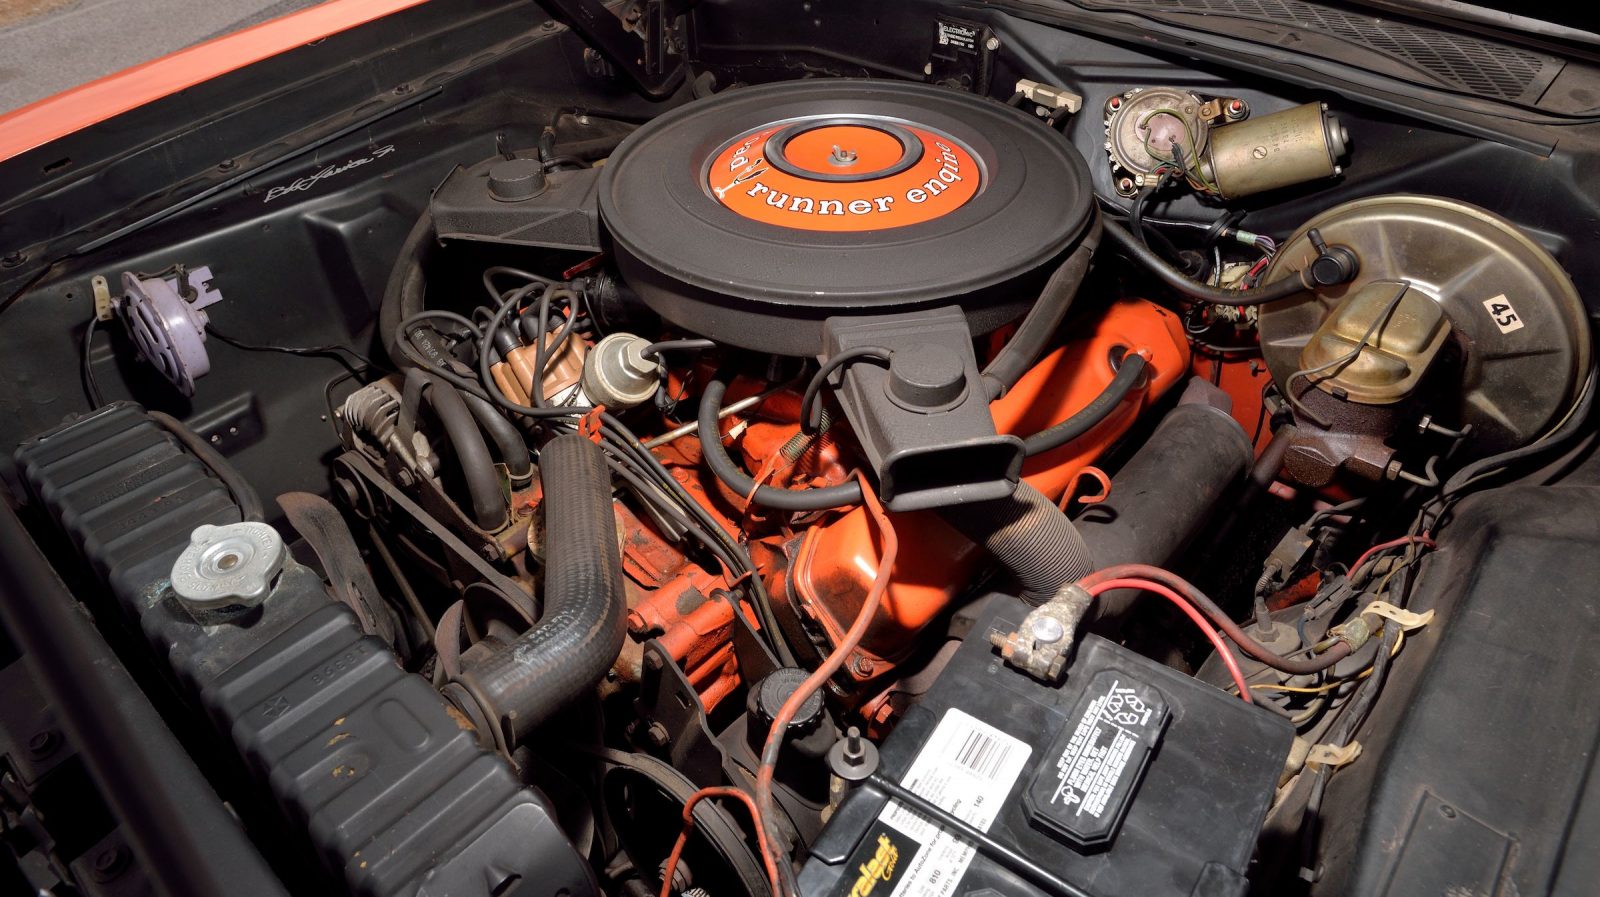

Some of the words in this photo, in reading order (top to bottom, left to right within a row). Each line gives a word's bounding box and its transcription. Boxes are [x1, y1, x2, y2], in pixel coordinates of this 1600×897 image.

[747, 181, 894, 216] runner
[906, 141, 963, 203] engine
[1491, 303, 1518, 326] 45
[914, 847, 932, 873] AutoZone
[929, 838, 937, 848] for
[928, 869, 941, 885] 810
[973, 795, 984, 808] 140
